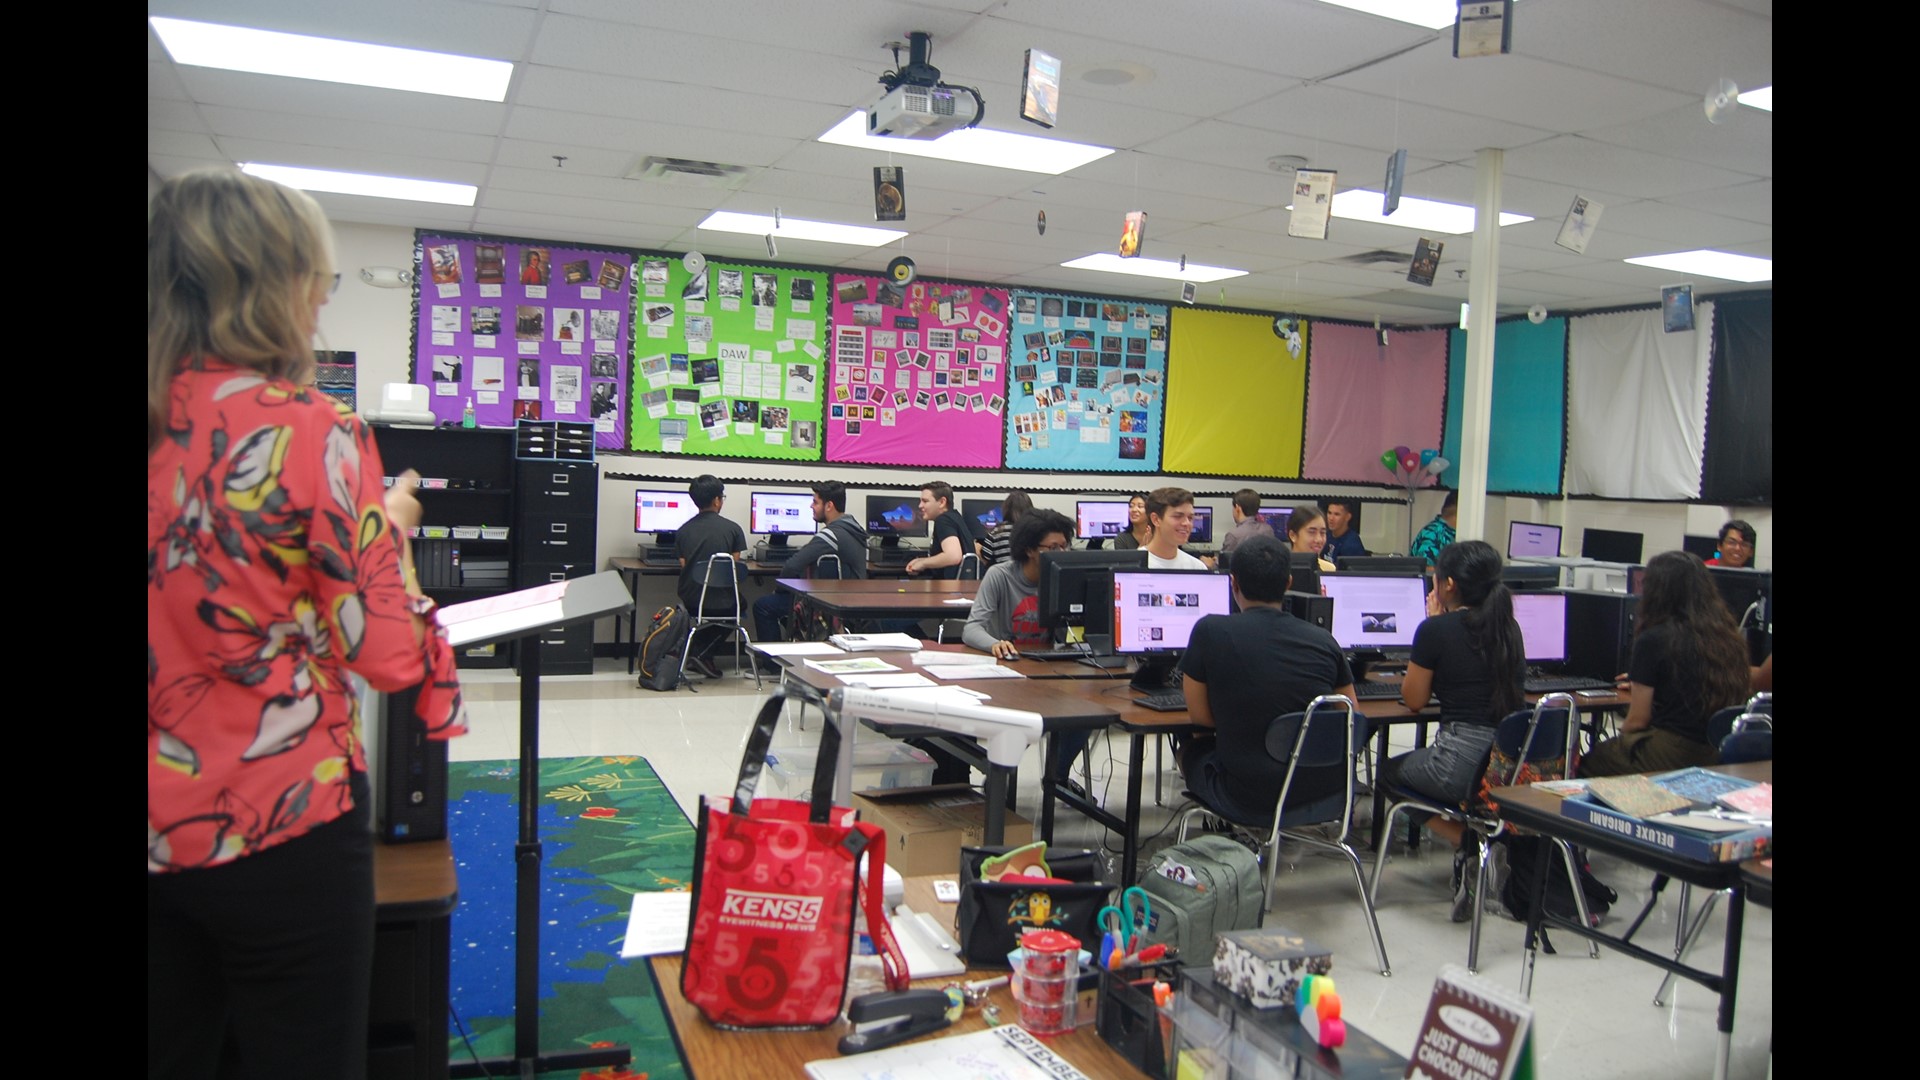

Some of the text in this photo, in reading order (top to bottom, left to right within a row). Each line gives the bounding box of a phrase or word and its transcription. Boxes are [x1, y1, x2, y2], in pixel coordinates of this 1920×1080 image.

[721, 348, 748, 360] DAW
[1589, 810, 1675, 849] DELUXE ORIGAMI
[754, 863, 769, 883] 5
[774, 863, 796, 888] 5
[719, 915, 817, 933] EYEWITNESS NEWS
[713, 931, 740, 968] 5
[726, 936, 789, 1011] 5
[1002, 1026, 1085, 1080] SEPTEMBE
[1423, 1027, 1458, 1056] JUST
[1456, 1041, 1499, 1074] BRING
